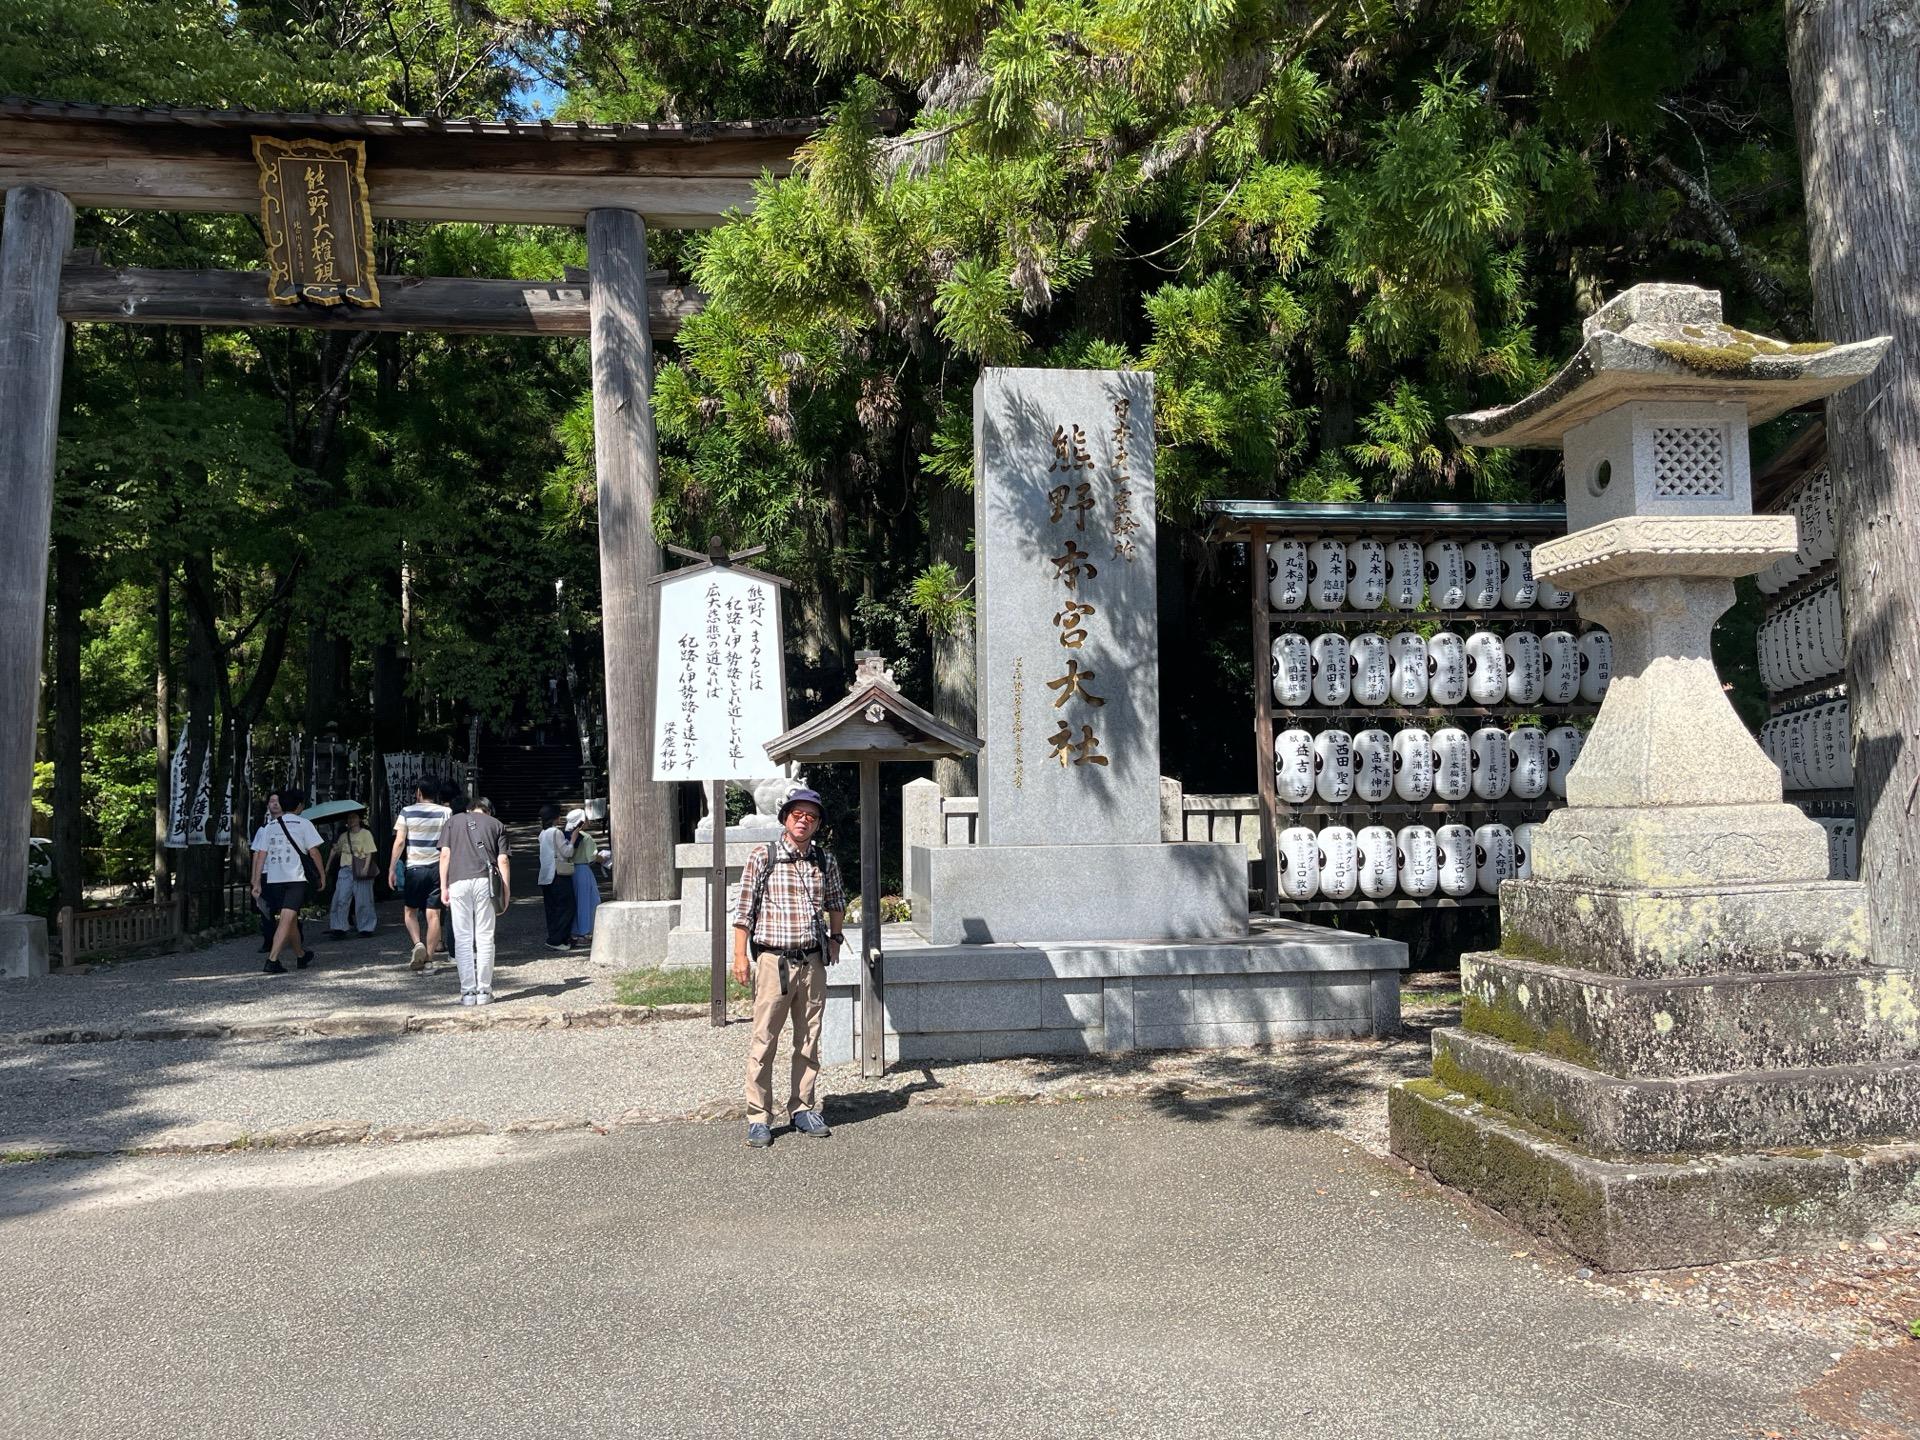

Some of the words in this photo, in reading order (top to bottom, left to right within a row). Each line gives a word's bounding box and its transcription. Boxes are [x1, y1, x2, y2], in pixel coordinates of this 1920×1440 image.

[1330, 553, 1342, 575] 丸本
[1370, 551, 1382, 574] 丸本
[1046, 423, 1109, 770] 熊野本宮大社
